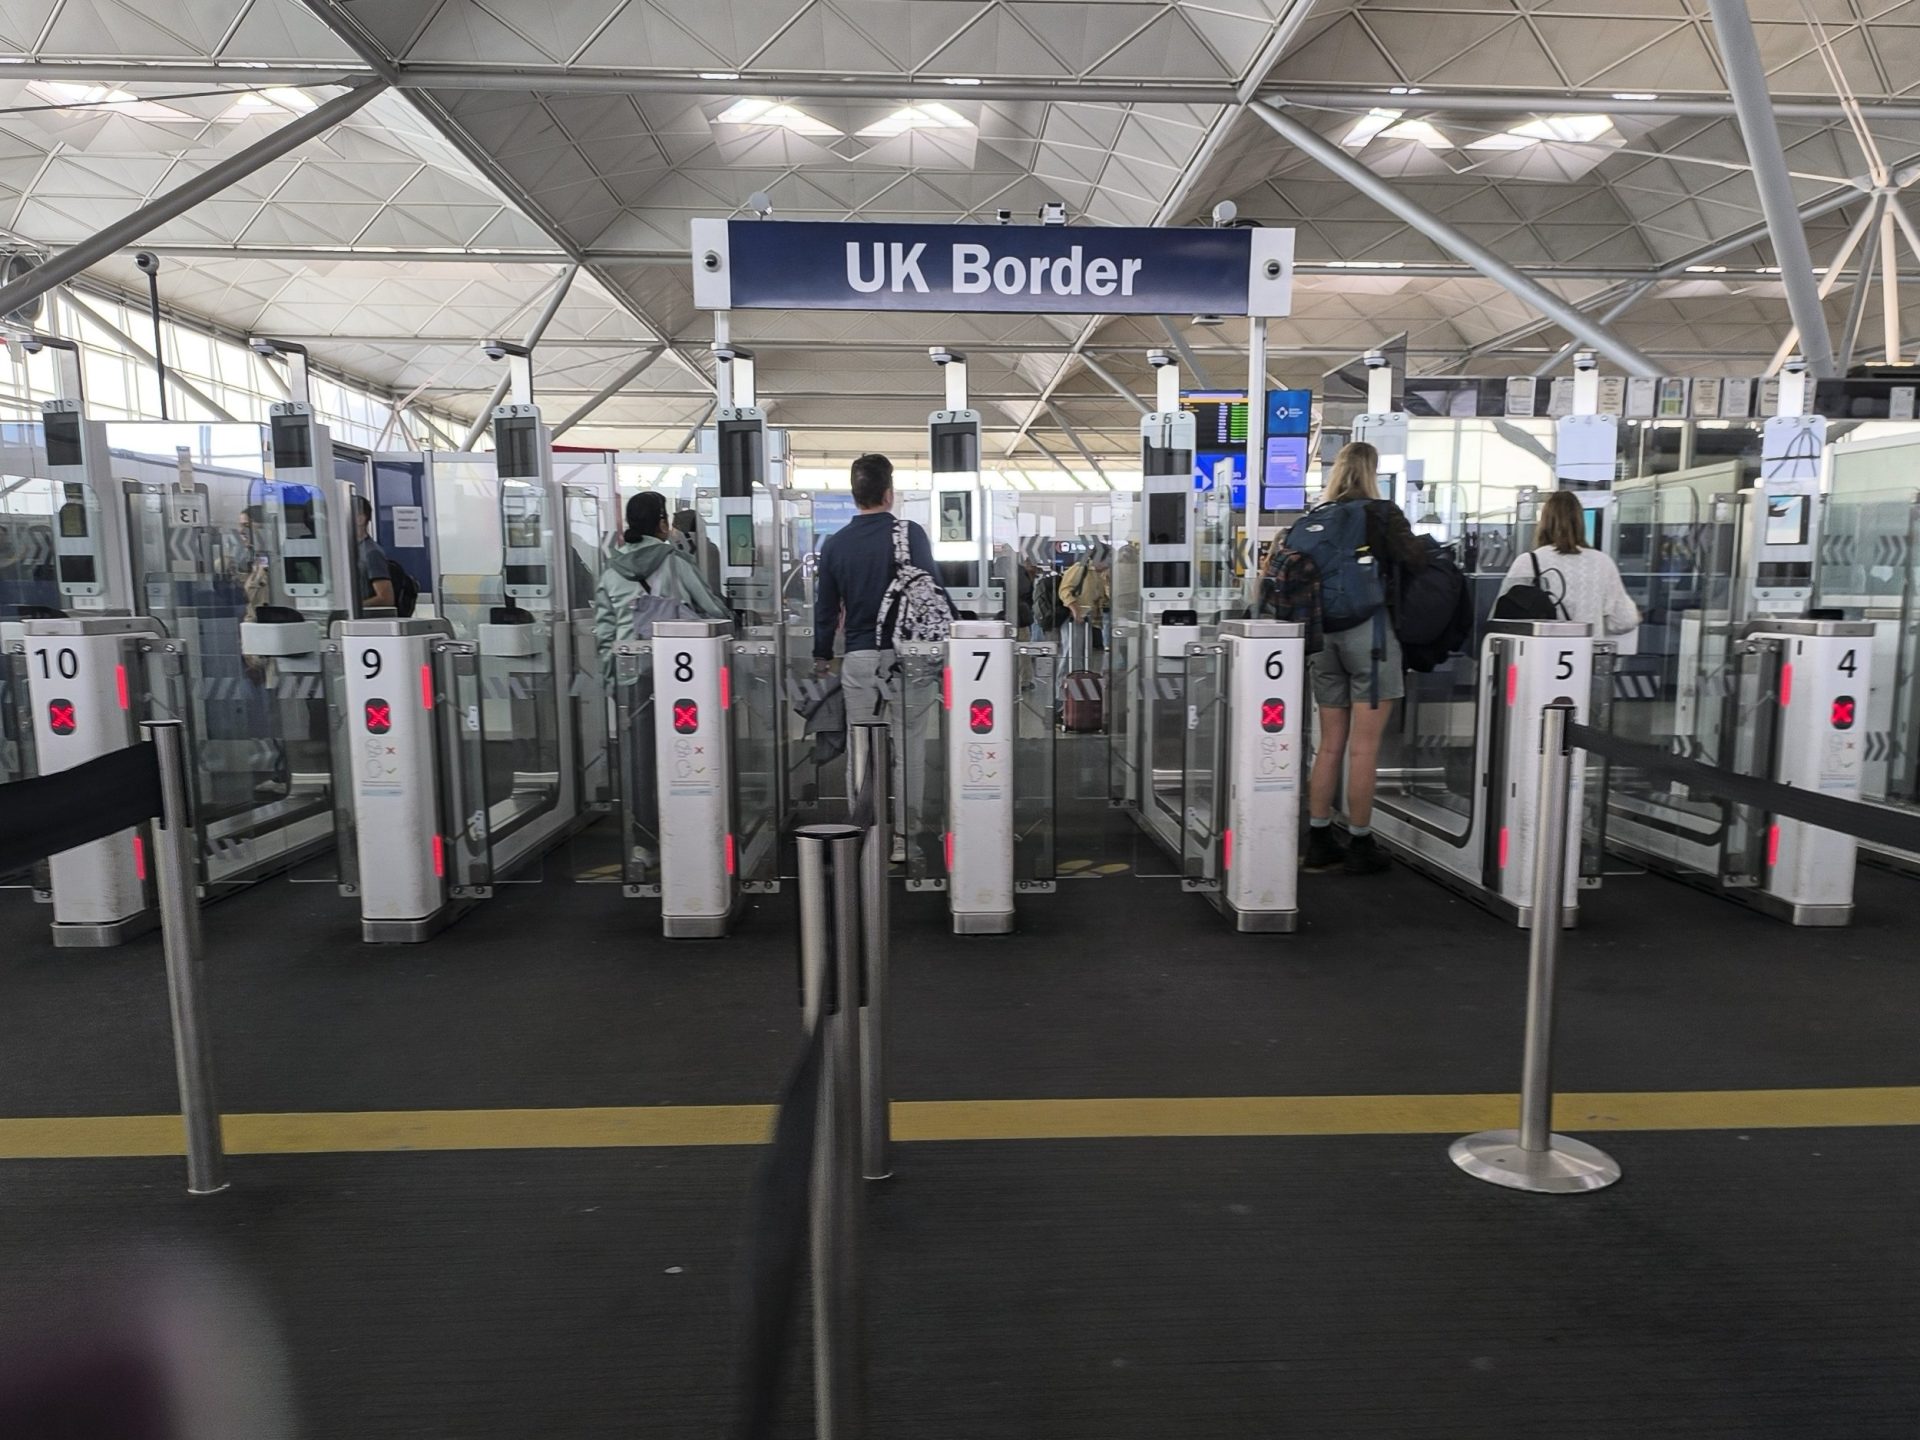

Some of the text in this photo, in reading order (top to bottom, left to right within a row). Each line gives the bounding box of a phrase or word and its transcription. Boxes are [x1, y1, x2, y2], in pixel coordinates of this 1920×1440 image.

[846, 241, 1142, 297] UK Border
[53, 400, 64, 413] 11
[281, 402, 295, 415] 10
[510, 404, 518, 418] 9
[735, 407, 743, 421] 8
[949, 411, 957, 423] 7
[1163, 412, 1172, 424] 6
[1378, 414, 1386, 426] 5
[34, 647, 78, 680] 10
[362, 648, 382, 680] 9
[674, 651, 694, 683] 8
[972, 651, 991, 682] 7
[1265, 650, 1284, 680] 6
[1555, 650, 1574, 681] 5
[1837, 649, 1857, 678] 4
